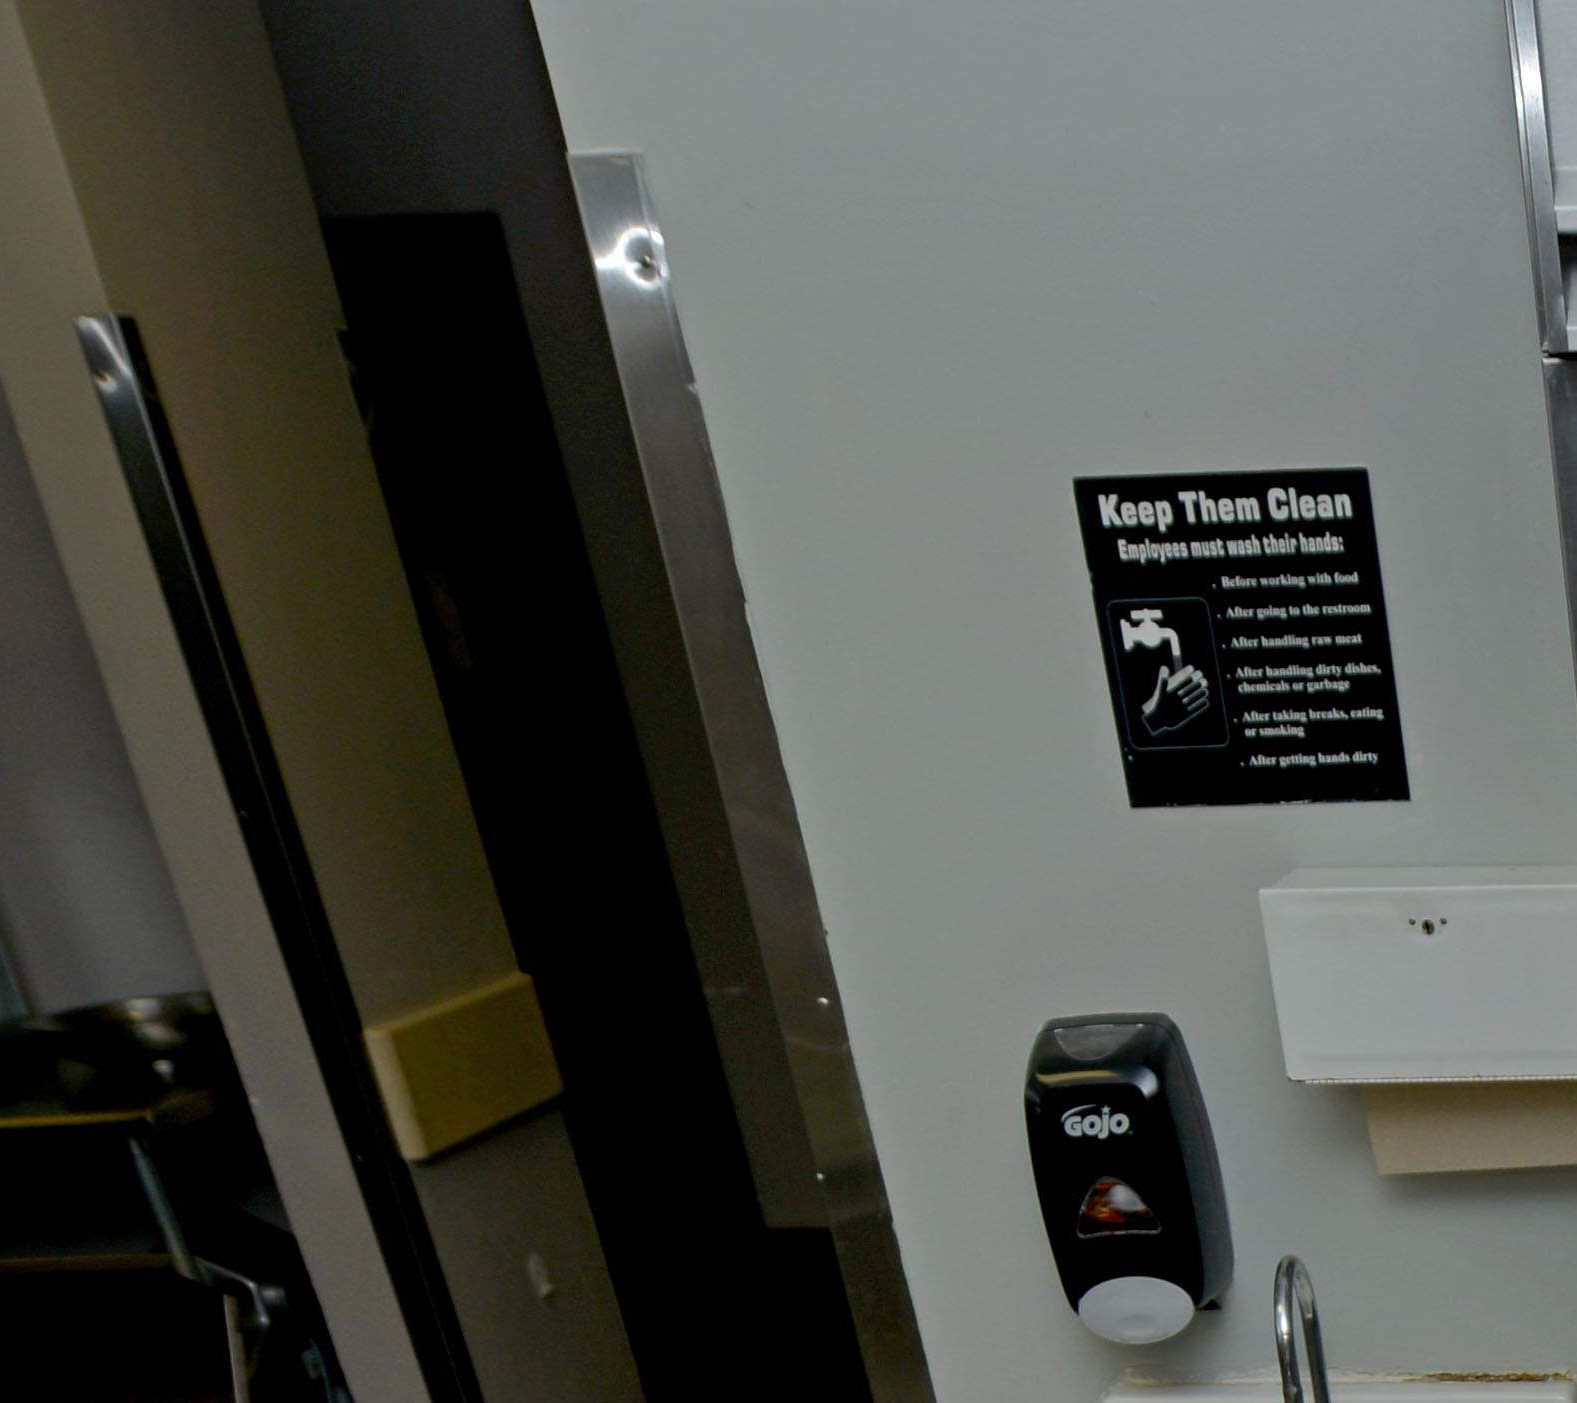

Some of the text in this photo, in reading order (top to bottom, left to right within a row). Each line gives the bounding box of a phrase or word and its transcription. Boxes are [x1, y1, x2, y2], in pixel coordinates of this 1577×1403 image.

[1097, 487, 1353, 533] Keep Them Clean
[1117, 531, 1345, 565] Employees must wash their hands:
[1221, 571, 1359, 590] Before working with food
[1225, 603, 1372, 621] After going to the restroom
[1230, 633, 1363, 650] After handling raw meat
[1235, 662, 1382, 680] After handling dirty dishes,
[1237, 679, 1351, 694] chemicals or garbage
[1242, 706, 1385, 724] After taking breaks, eating
[1244, 724, 1306, 739] or smoking
[1249, 751, 1378, 768] After getting hands dirty
